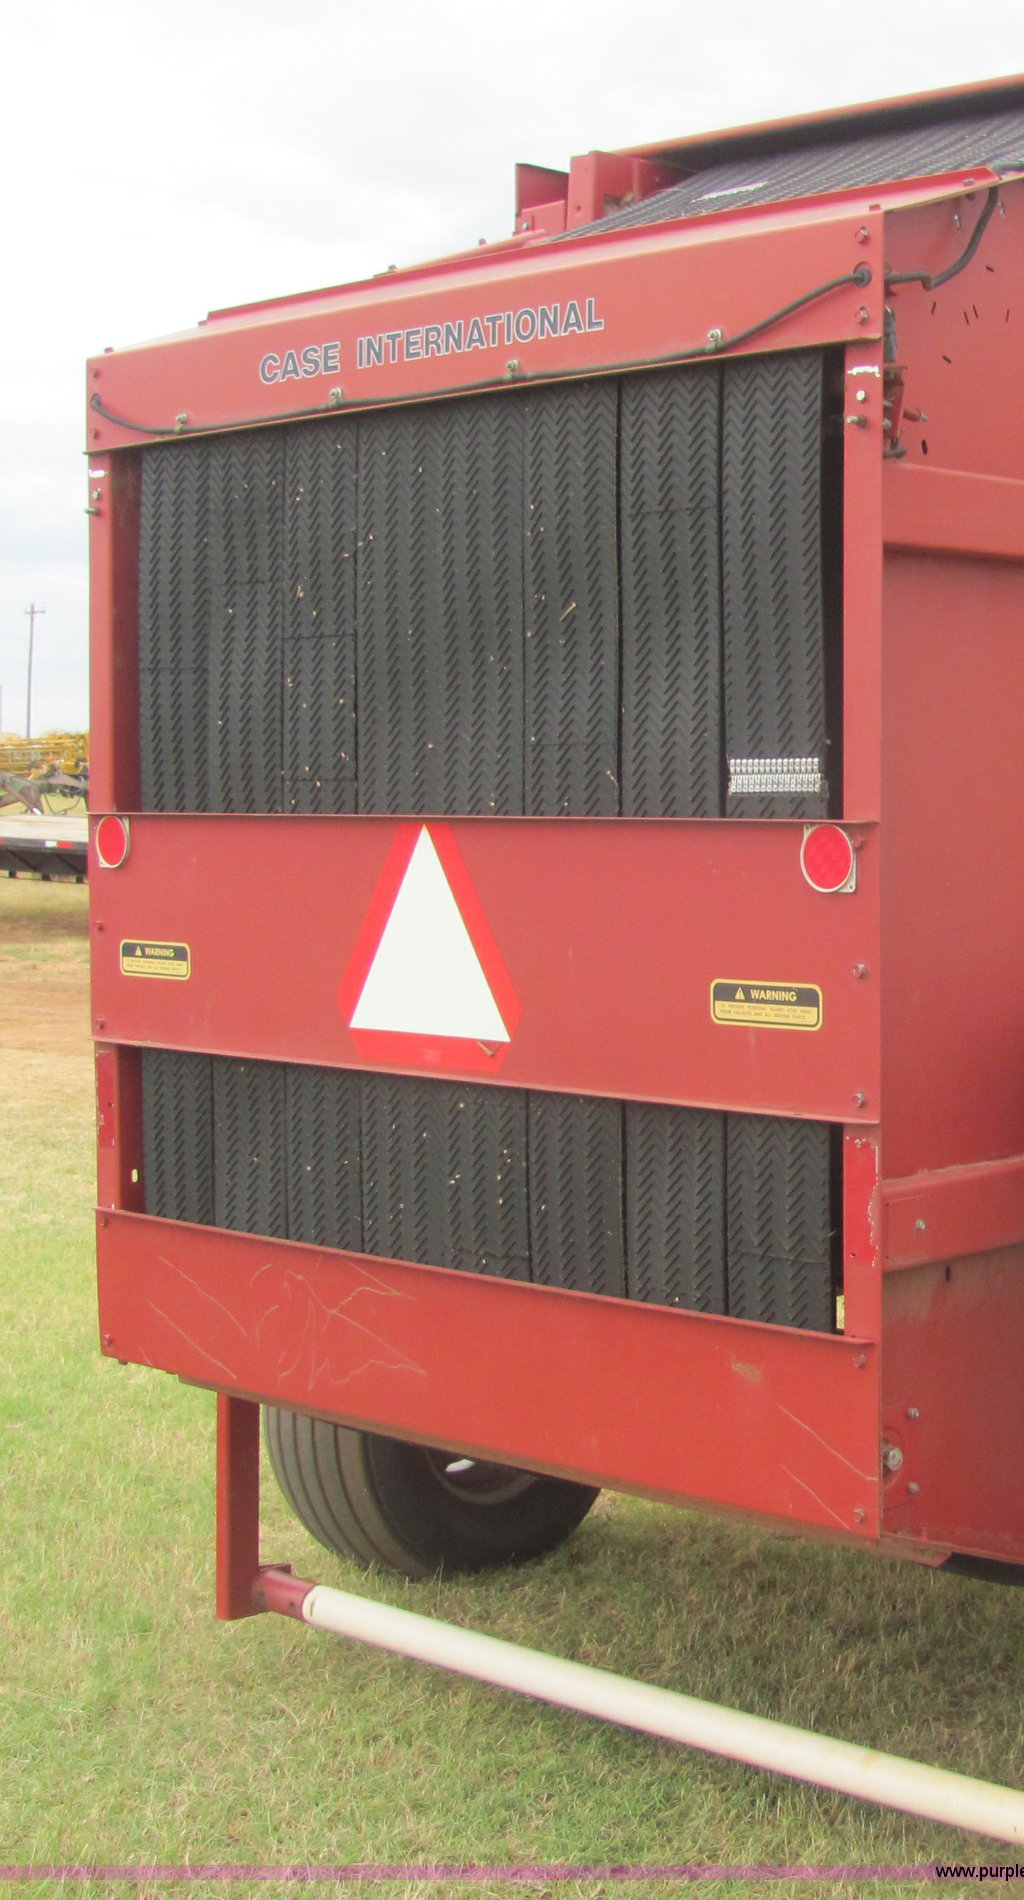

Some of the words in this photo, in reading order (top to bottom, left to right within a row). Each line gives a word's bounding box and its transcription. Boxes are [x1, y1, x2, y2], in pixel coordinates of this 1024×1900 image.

[259, 341, 341, 385] CASE
[356, 298, 605, 369] INTERNATIONAL
[144, 947, 175, 957] WARNING
[750, 988, 798, 1002] WARNING
